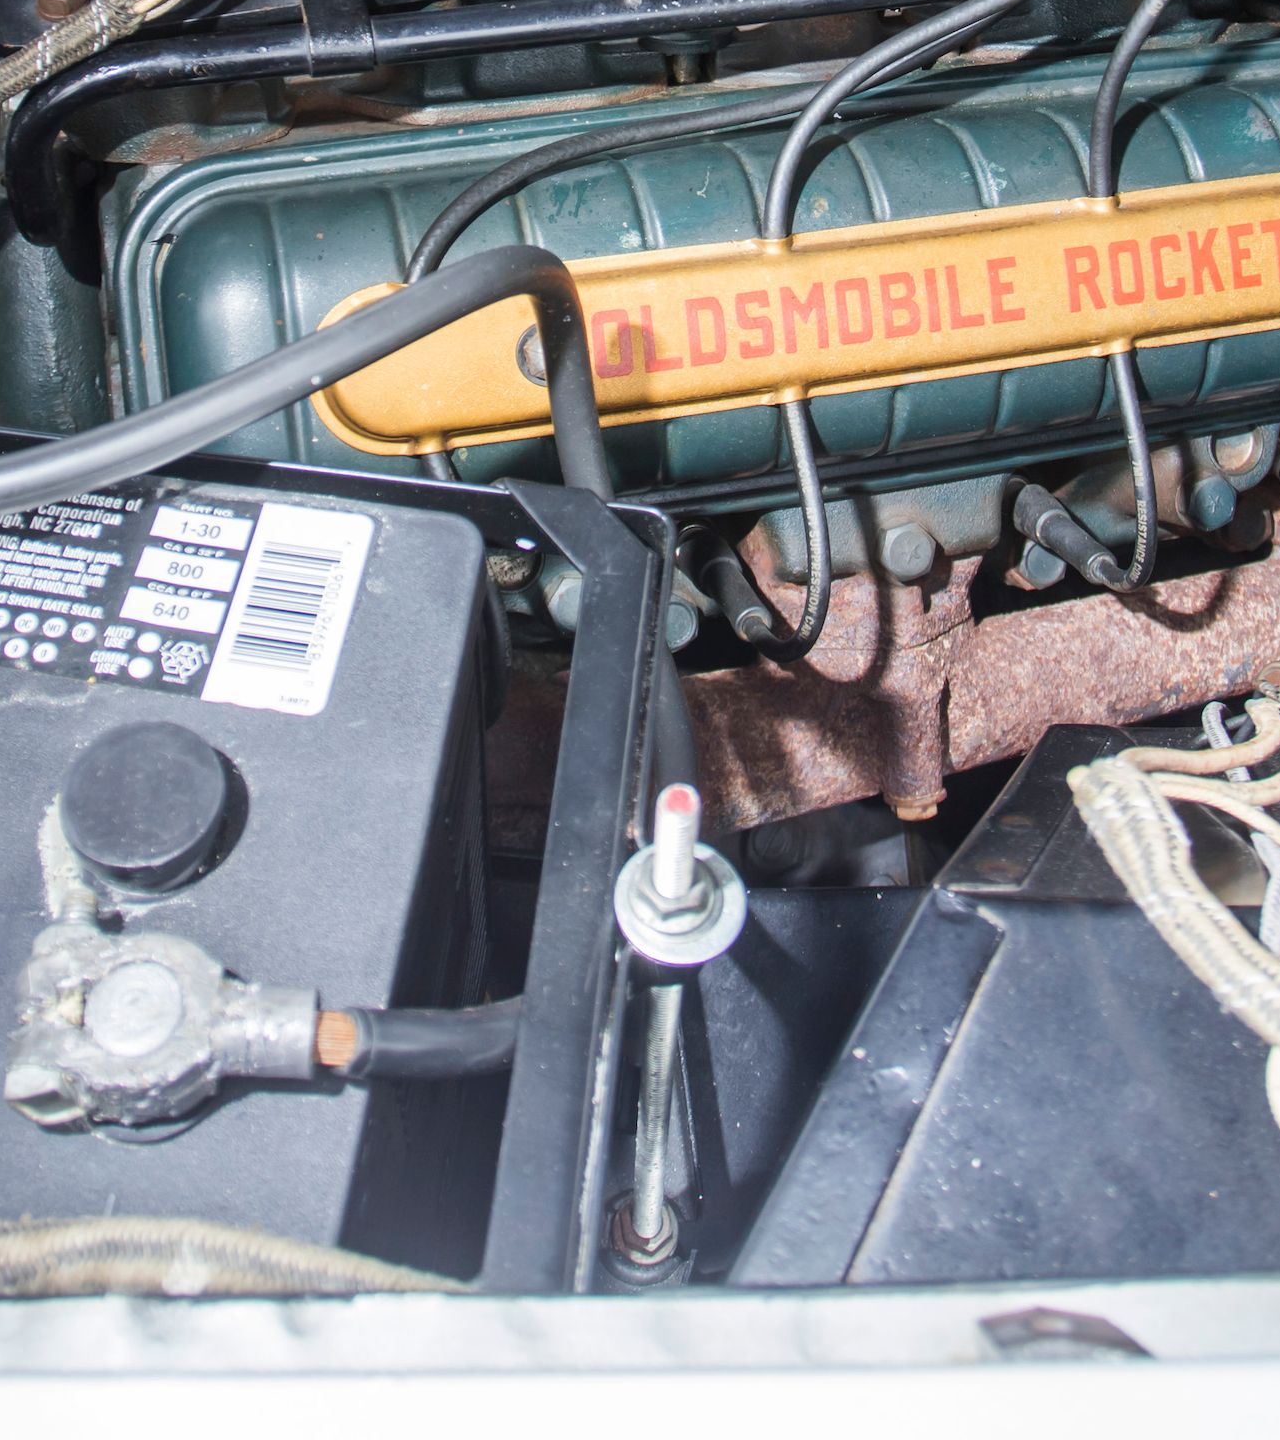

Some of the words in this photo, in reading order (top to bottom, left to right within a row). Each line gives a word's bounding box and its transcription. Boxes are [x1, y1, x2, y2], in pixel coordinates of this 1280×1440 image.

[591, 256, 1025, 379] OLDSMOBILE
[123, 496, 144, 512] of
[180, 503, 212, 514] PART
[212, 507, 234, 517] NO.
[35, 501, 124, 528] Corporation
[28, 515, 53, 532] NC
[52, 518, 103, 539] 27604
[179, 520, 222, 539] 1-30
[1136, 498, 1149, 563] RESISTANCE
[161, 542, 183, 553] CA
[11, 551, 35, 564] lead
[86, 561, 109, 575] and
[166, 561, 204, 579] 800
[808, 529, 822, 613] SUPPRESSION
[0, 573, 34, 589] AFTER
[3, 562, 32, 576] cause
[30, 566, 63, 581] cancer
[61, 570, 81, 583] and
[80, 573, 106, 586] birth
[145, 581, 176, 595] CCA
[6, 592, 44, 608] SHOW
[41, 597, 72, 612] DATE
[69, 602, 106, 618] SOLD.
[151, 601, 190, 621] 640
[103, 624, 136, 640] AUTO
[308, 615, 332, 660] 83996
[103, 636, 128, 649] USE
[89, 648, 130, 667] COMM.
[94, 662, 120, 675] USE
